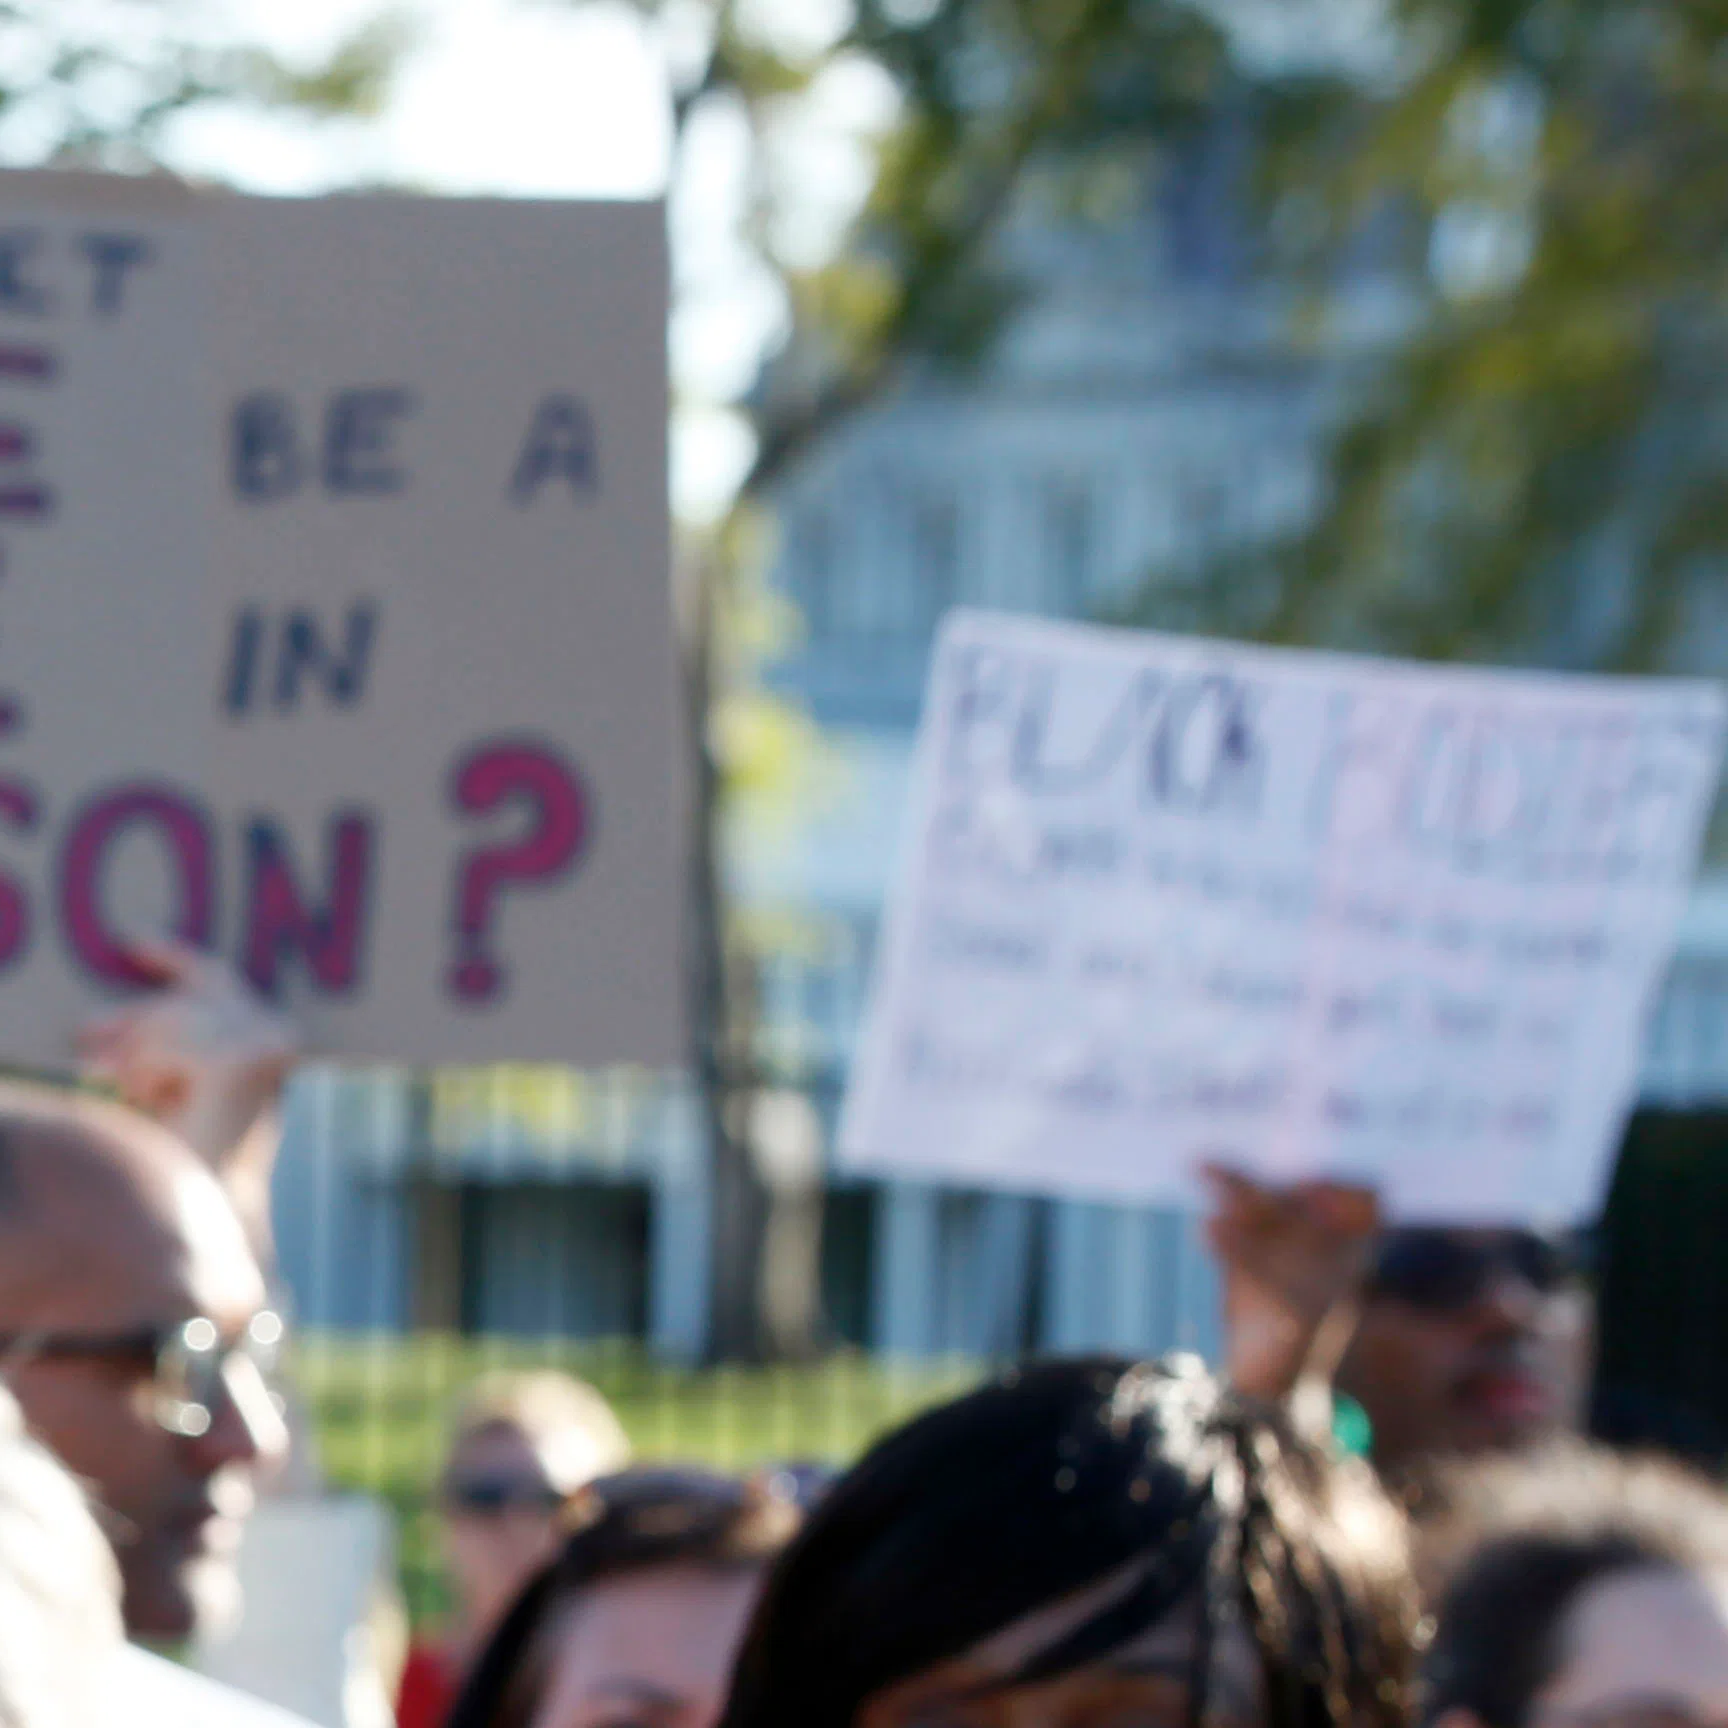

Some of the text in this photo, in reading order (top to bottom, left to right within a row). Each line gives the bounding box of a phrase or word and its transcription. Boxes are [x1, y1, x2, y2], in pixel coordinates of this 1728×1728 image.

[227, 386, 412, 505] BE
[507, 397, 601, 502] A
[222, 600, 375, 718] IN
